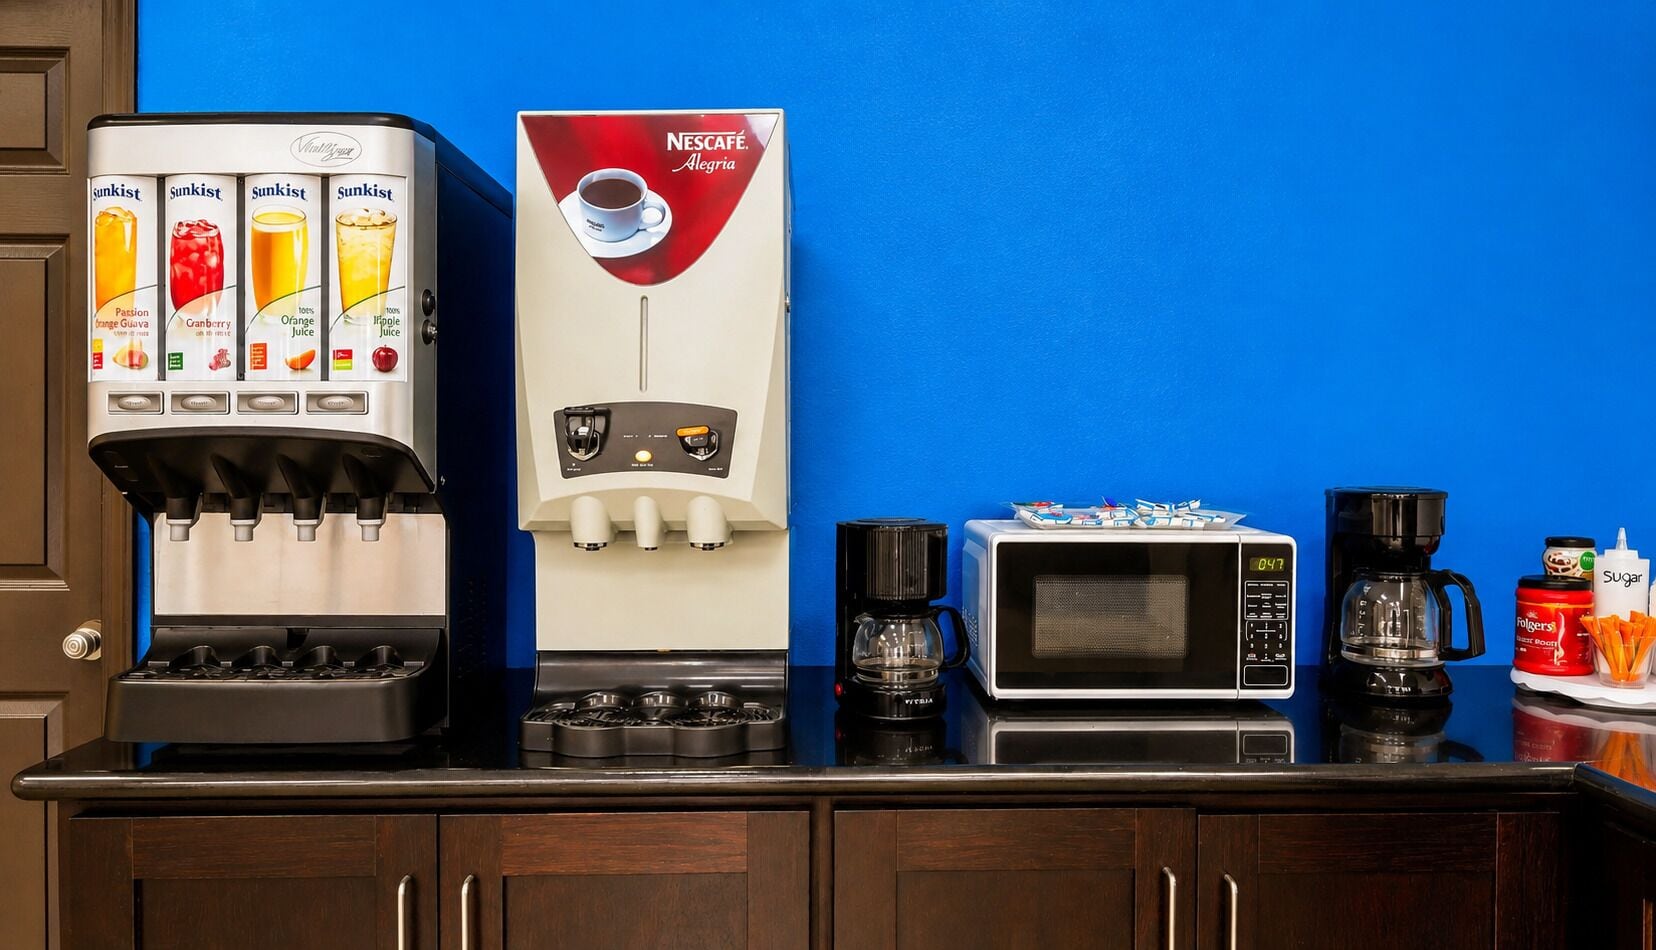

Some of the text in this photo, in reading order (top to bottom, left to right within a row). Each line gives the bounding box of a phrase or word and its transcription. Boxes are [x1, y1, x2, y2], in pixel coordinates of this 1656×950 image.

[671, 153, 736, 174] Alegria
[93, 184, 142, 201] Sunkist
[170, 183, 222, 200] Sunkist
[252, 183, 307, 200] Sunkist
[337, 183, 394, 200] Sunkist
[115, 308, 149, 317] Passion
[186, 319, 231, 329] Cranberry
[281, 315, 314, 328] Orange
[291, 327, 314, 338] Juice
[379, 325, 400, 338] Juice
[1603, 570, 1643, 587] Sugar
